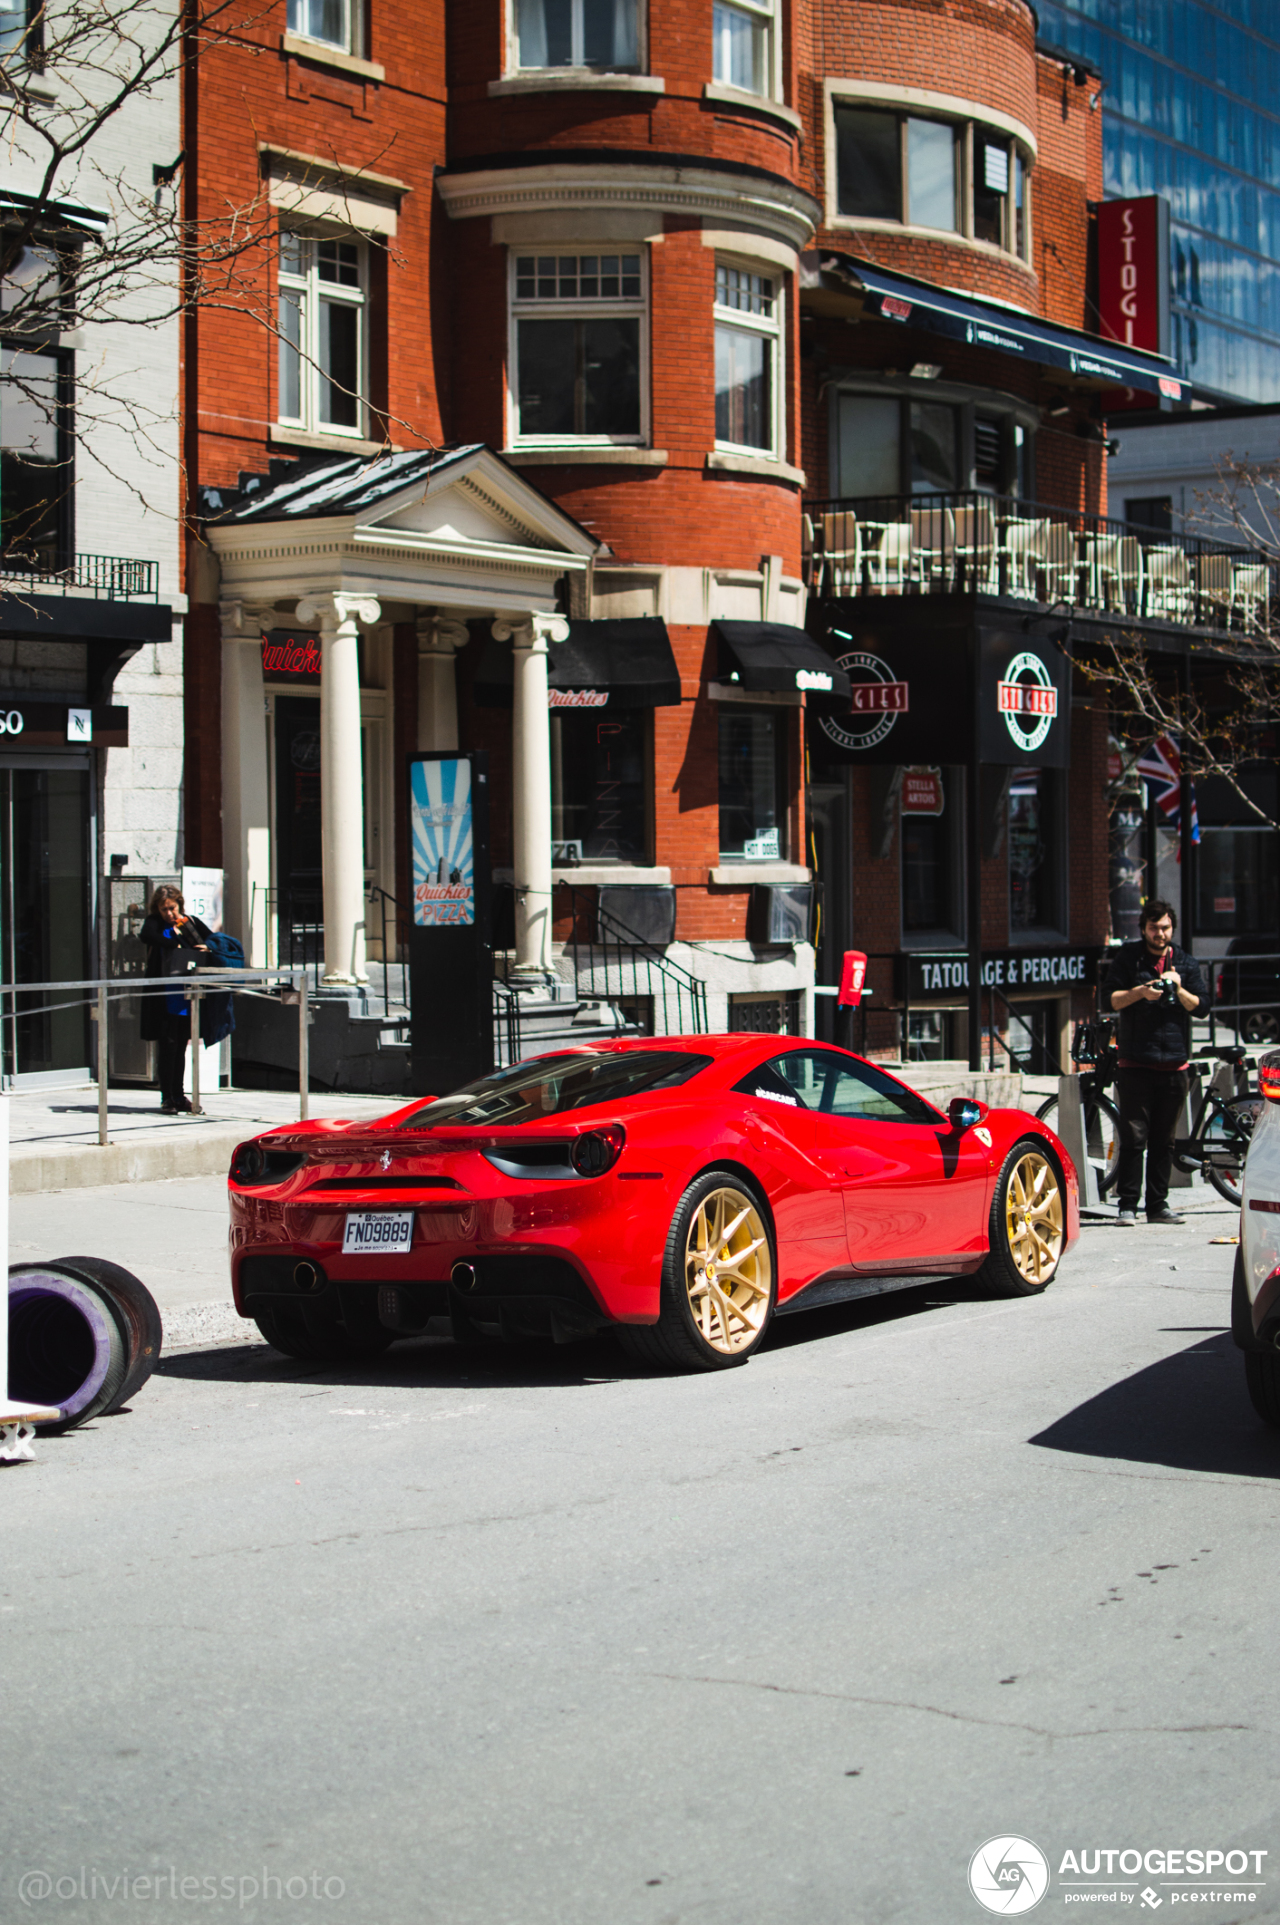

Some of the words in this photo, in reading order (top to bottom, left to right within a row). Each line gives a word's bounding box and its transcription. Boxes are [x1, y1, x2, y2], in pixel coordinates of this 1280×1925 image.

[1121, 208, 1137, 402] STOGI
[597, 723, 626, 858] PIZZA
[907, 780, 935, 791] STELLA
[907, 792, 936, 804] ARTOIS
[762, 843, 777, 856] DOGS
[416, 882, 472, 901] Quickies
[422, 903, 469, 922] PIZZA
[921, 960, 1004, 989] TATOUGE
[1007, 959, 1018, 984] &
[1022, 956, 1086, 985] PERÇAGE
[371, 1214, 394, 1222] Québec
[346, 1222, 409, 1243] FND9889
